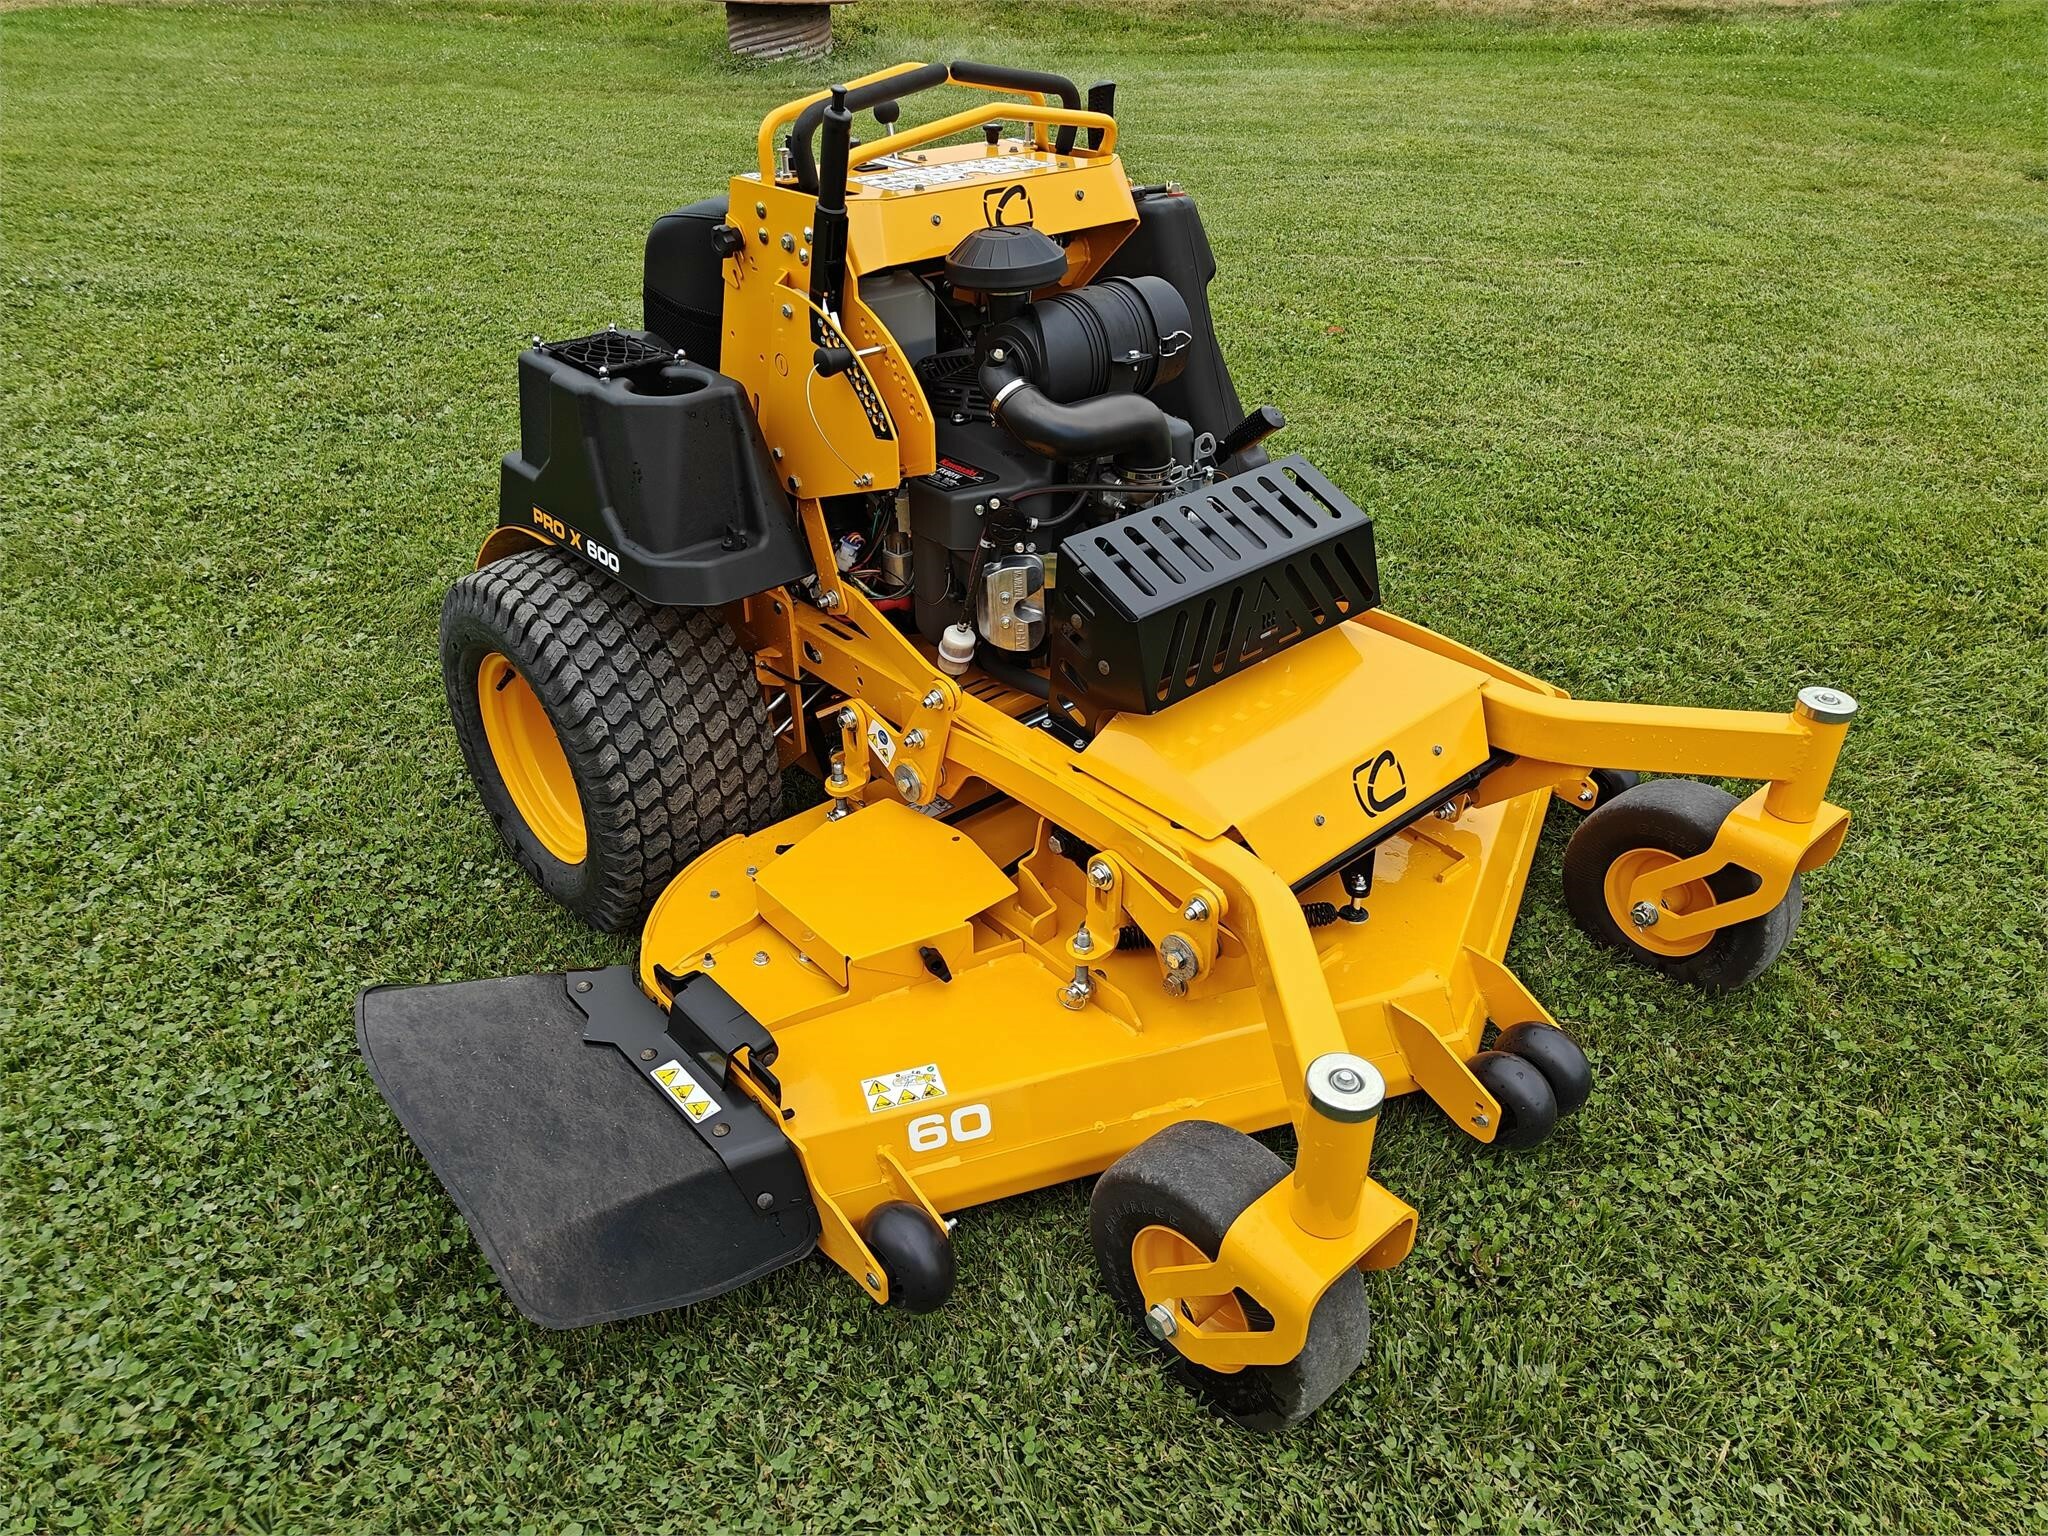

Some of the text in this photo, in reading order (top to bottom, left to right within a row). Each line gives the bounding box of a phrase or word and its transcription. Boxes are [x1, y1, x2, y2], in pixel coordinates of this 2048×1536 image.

[939, 458, 979, 477] Kawasaki
[533, 507, 620, 573] PRO X 600
[908, 1103, 992, 1152] 60
